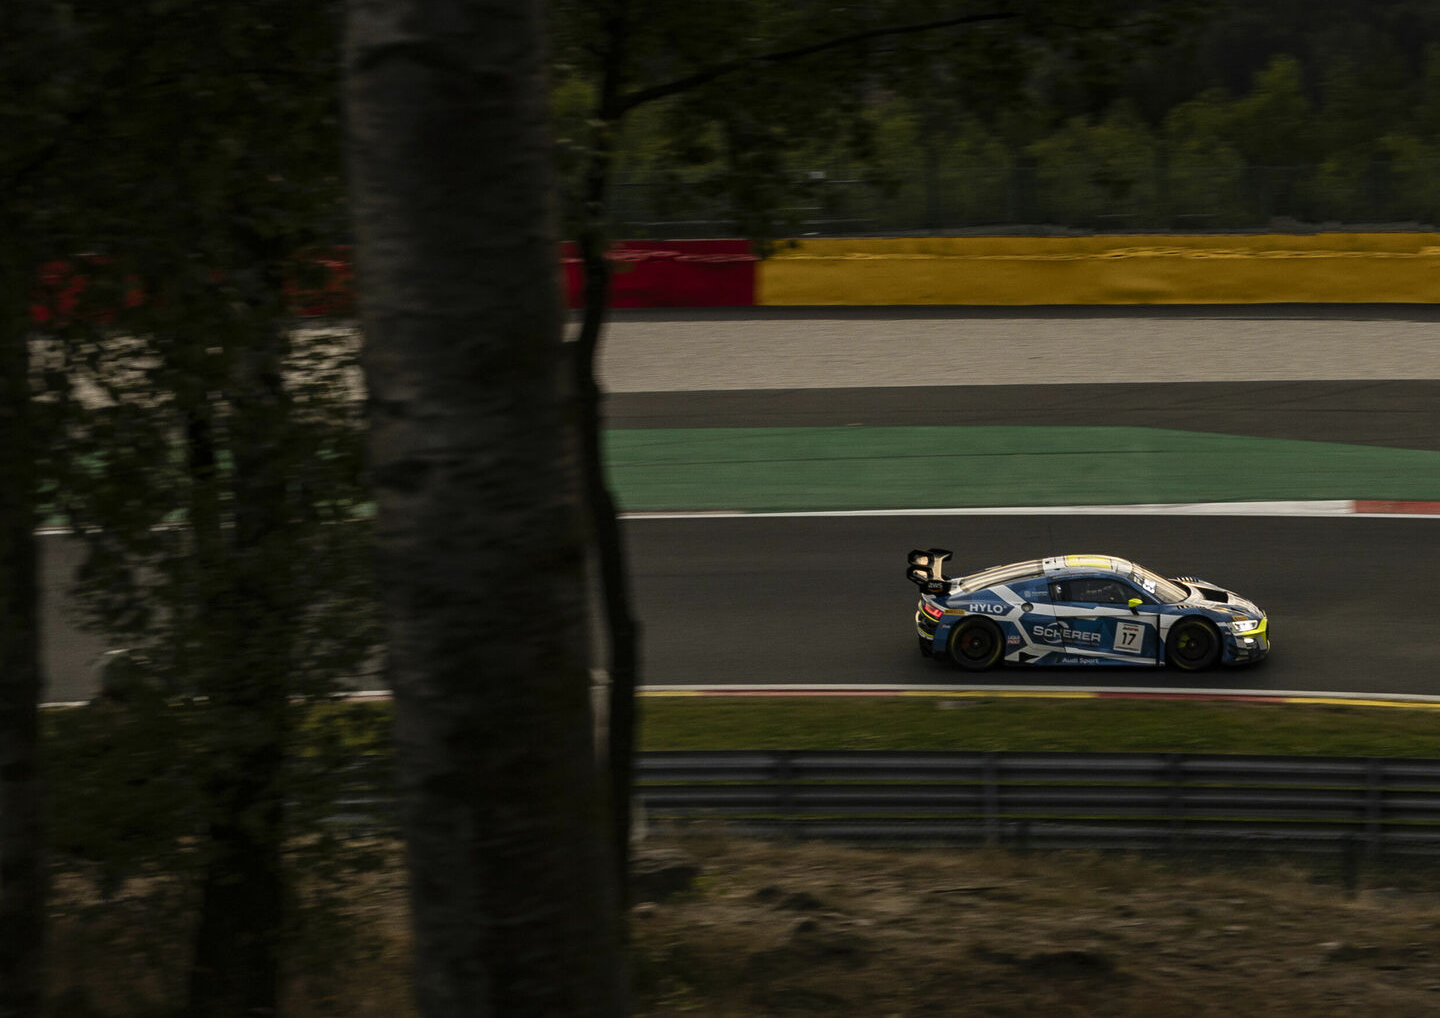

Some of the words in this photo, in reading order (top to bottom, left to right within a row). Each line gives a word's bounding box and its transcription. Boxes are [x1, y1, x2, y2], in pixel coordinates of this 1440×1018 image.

[969, 604, 1003, 614] HYLO
[1032, 625, 1101, 642] SCHERER
[1122, 632, 1136, 645] 17
